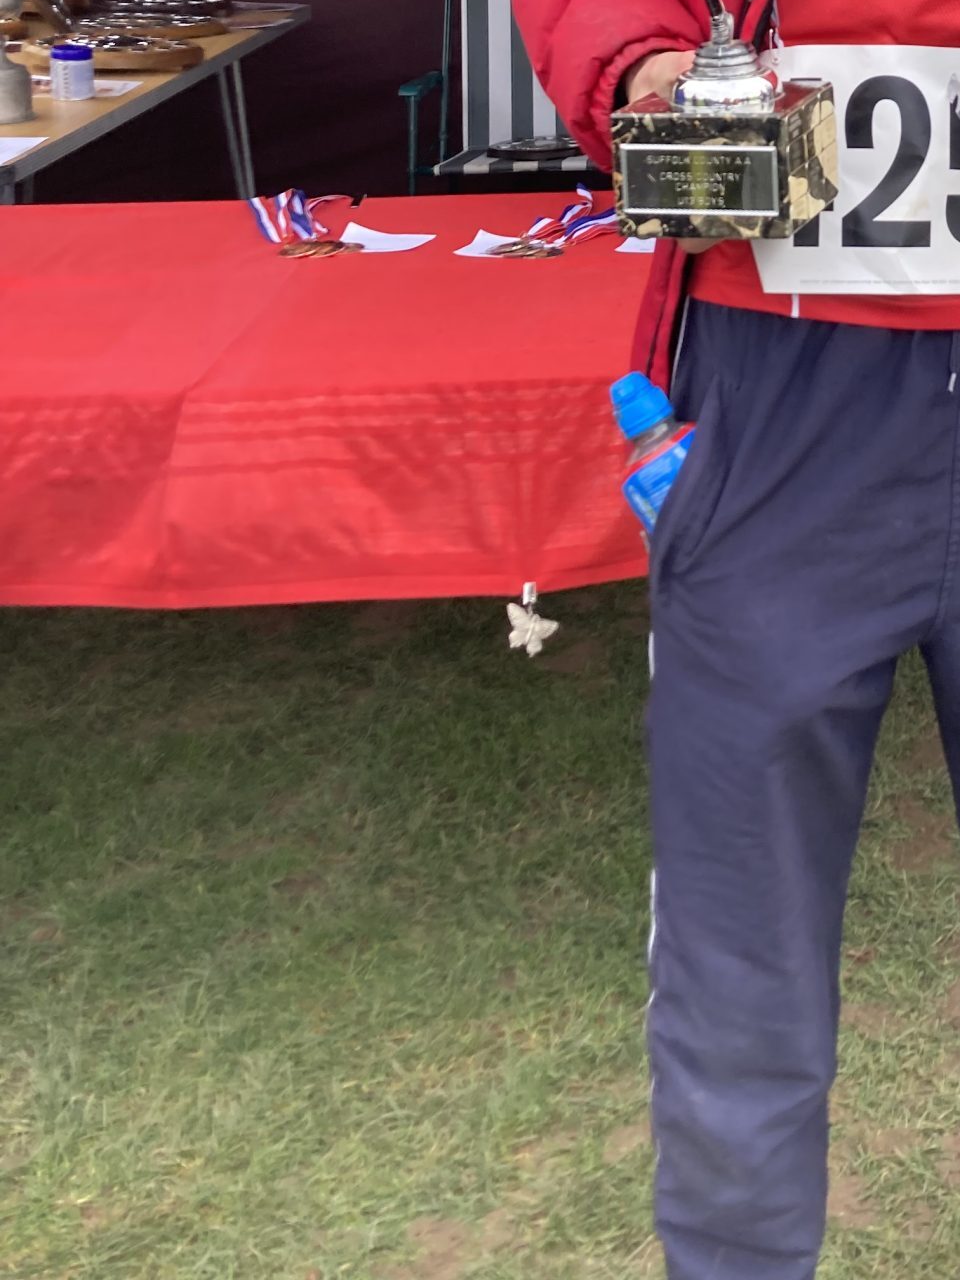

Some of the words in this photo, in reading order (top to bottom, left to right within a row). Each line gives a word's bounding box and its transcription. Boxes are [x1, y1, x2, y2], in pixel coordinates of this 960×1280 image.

[646, 155, 690, 165] SUFFOLK
[693, 155, 731, 165] COUNTY
[660, 171, 692, 181] CROSS
[694, 172, 740, 182] COUNTRY
